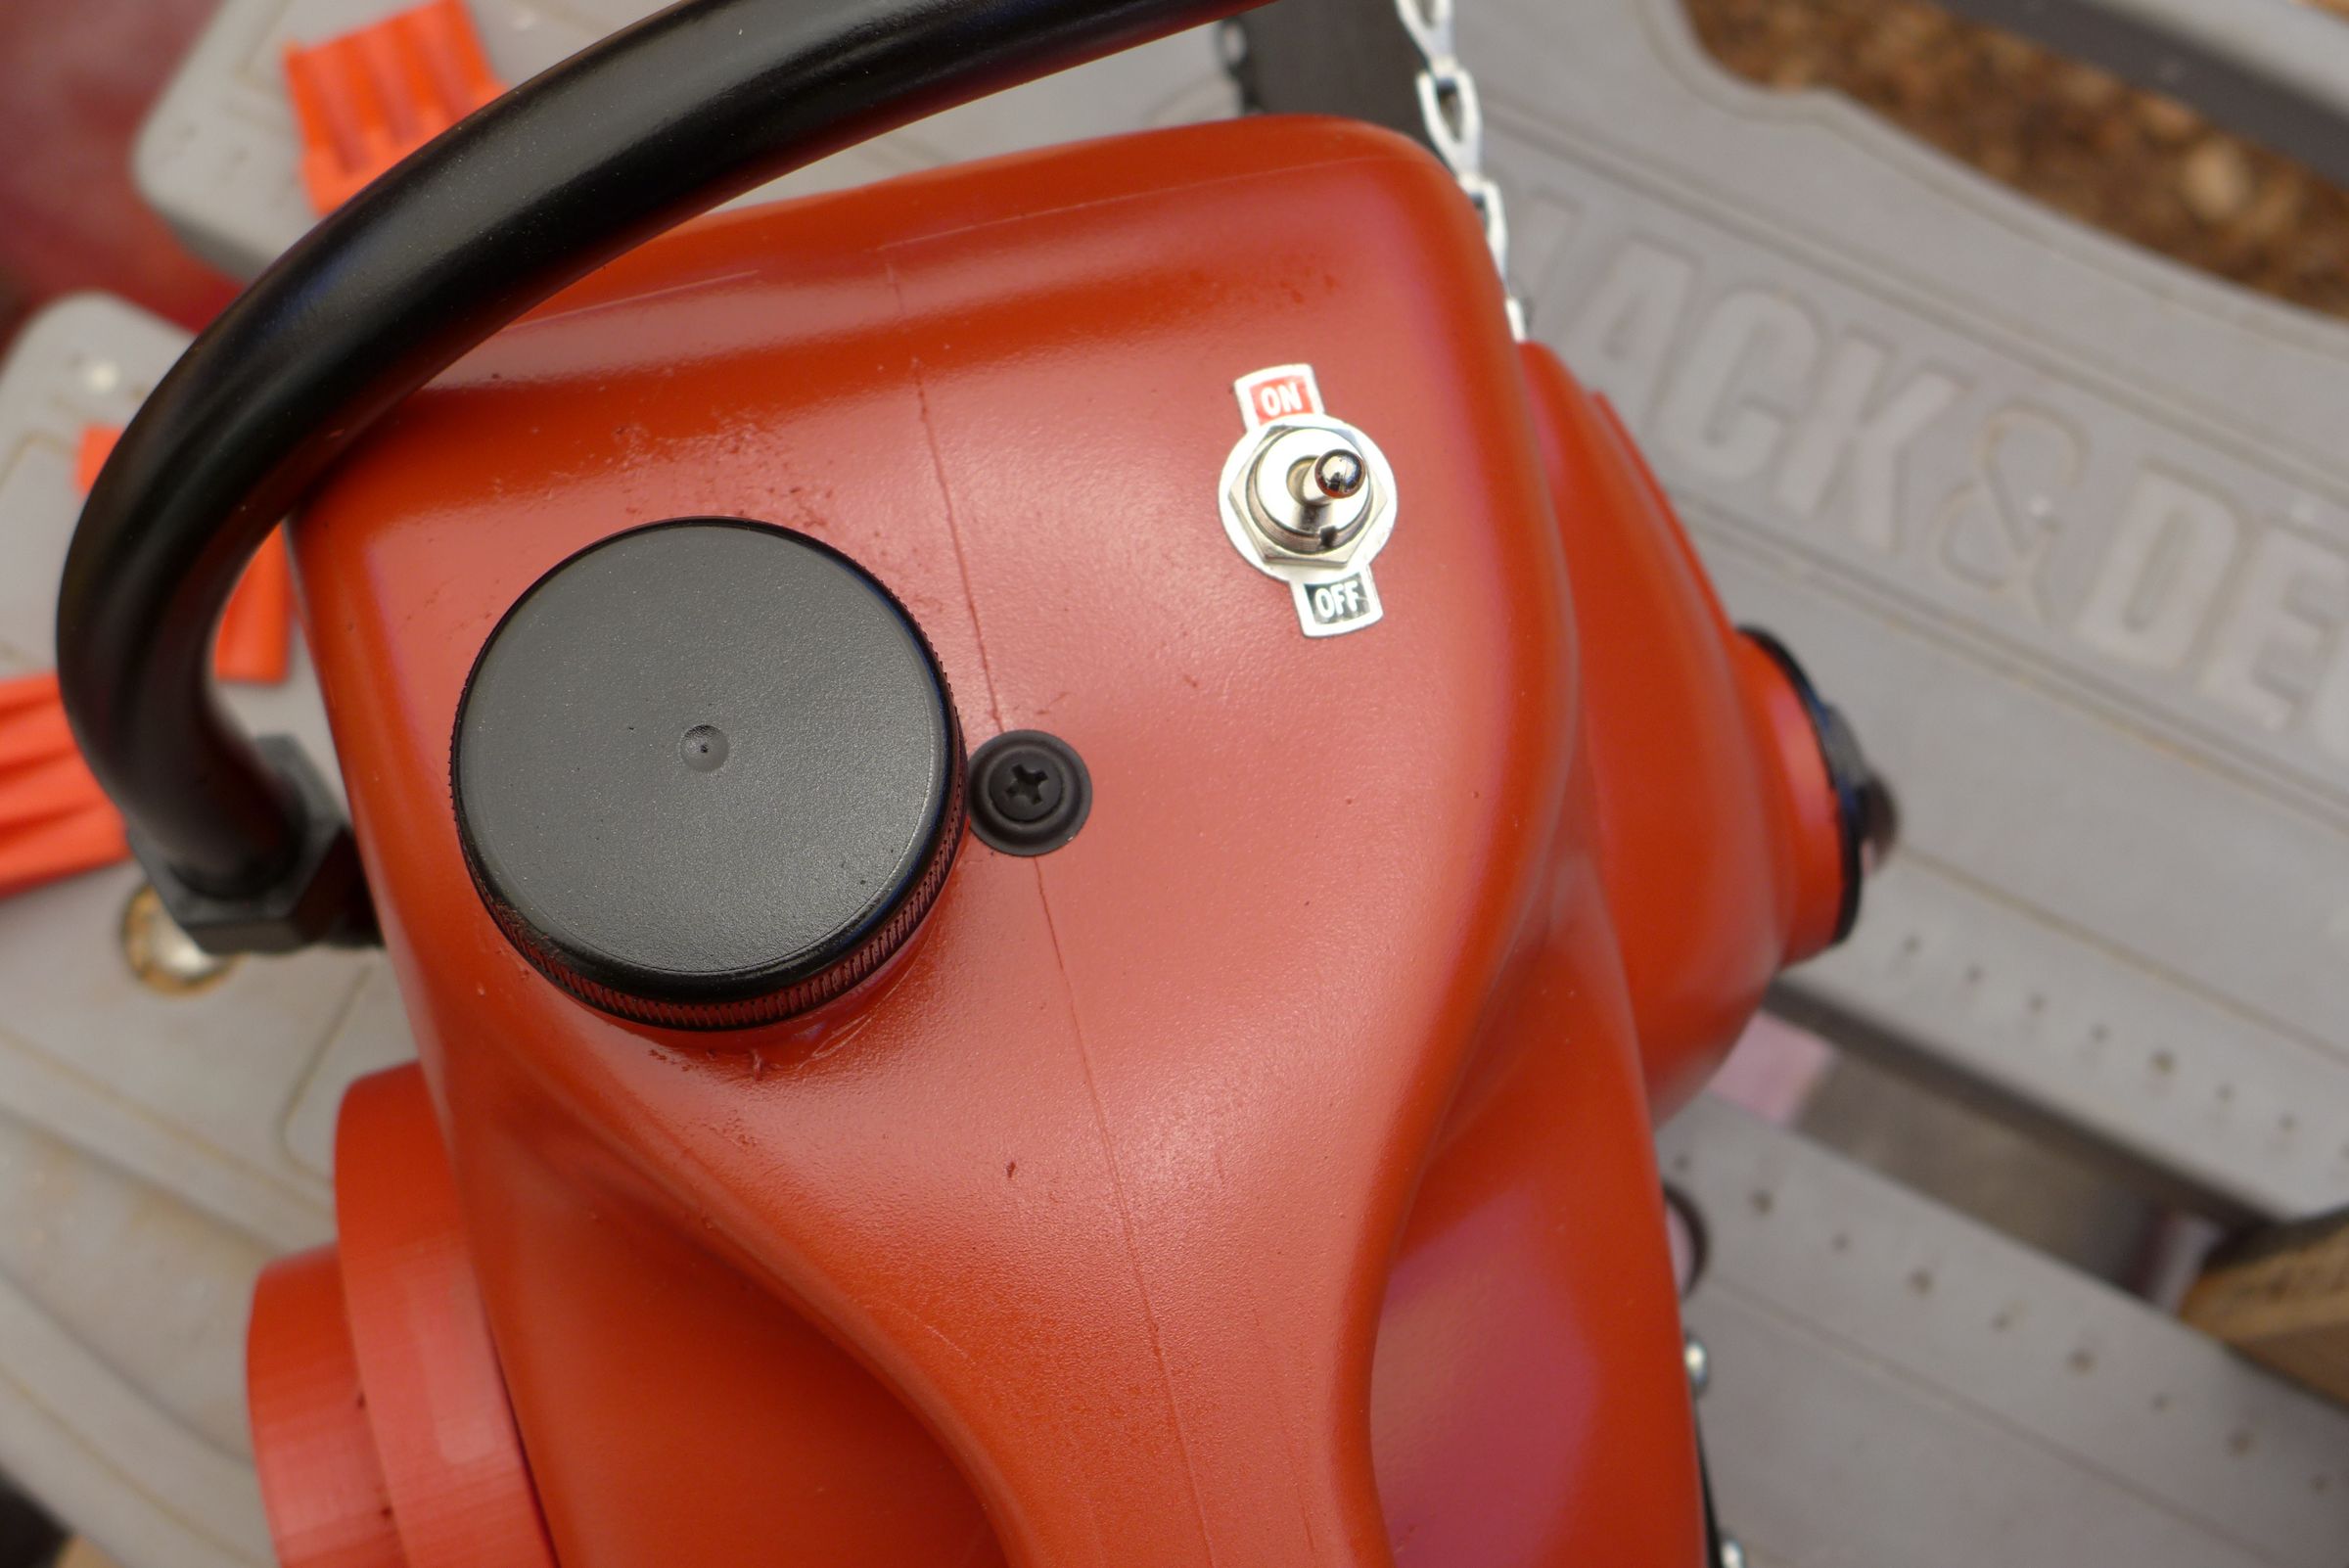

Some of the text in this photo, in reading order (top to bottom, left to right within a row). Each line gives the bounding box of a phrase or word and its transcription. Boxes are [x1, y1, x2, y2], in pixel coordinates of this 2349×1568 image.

[1260, 382, 1303, 416] ON
[1929, 397, 2091, 626] &
[2073, 460, 2349, 756] DE
[1314, 579, 1359, 619] OFF
